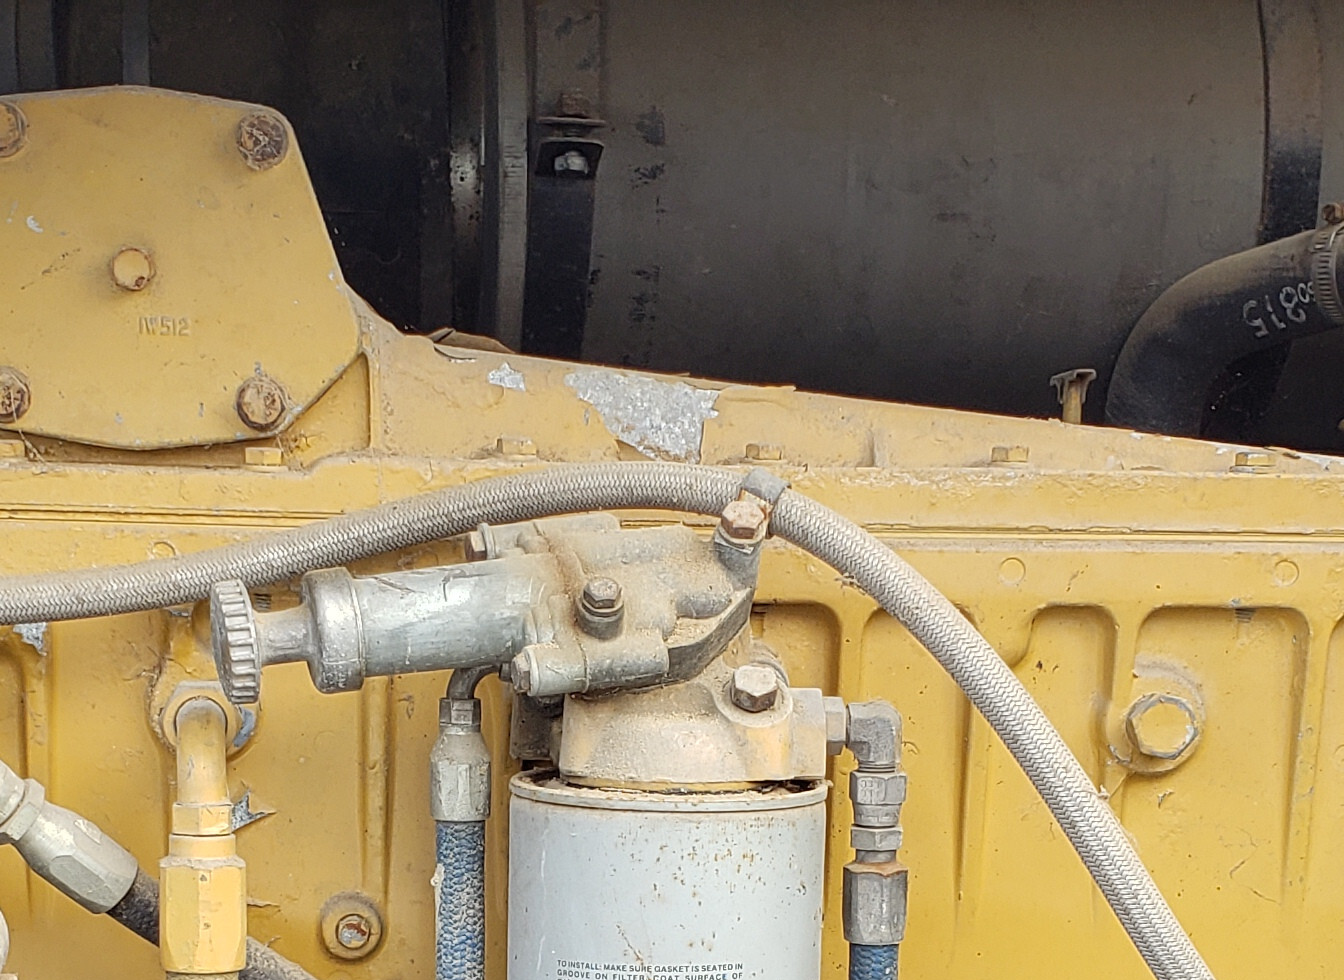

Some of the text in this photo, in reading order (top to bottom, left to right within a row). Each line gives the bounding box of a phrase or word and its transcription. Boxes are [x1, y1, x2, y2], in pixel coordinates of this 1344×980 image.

[603, 964, 627, 972] MAKE
[701, 964, 733, 972] SEATED
[557, 969, 590, 979] GROOVE
[595, 972, 608, 980] ON
[732, 972, 743, 980] OF
